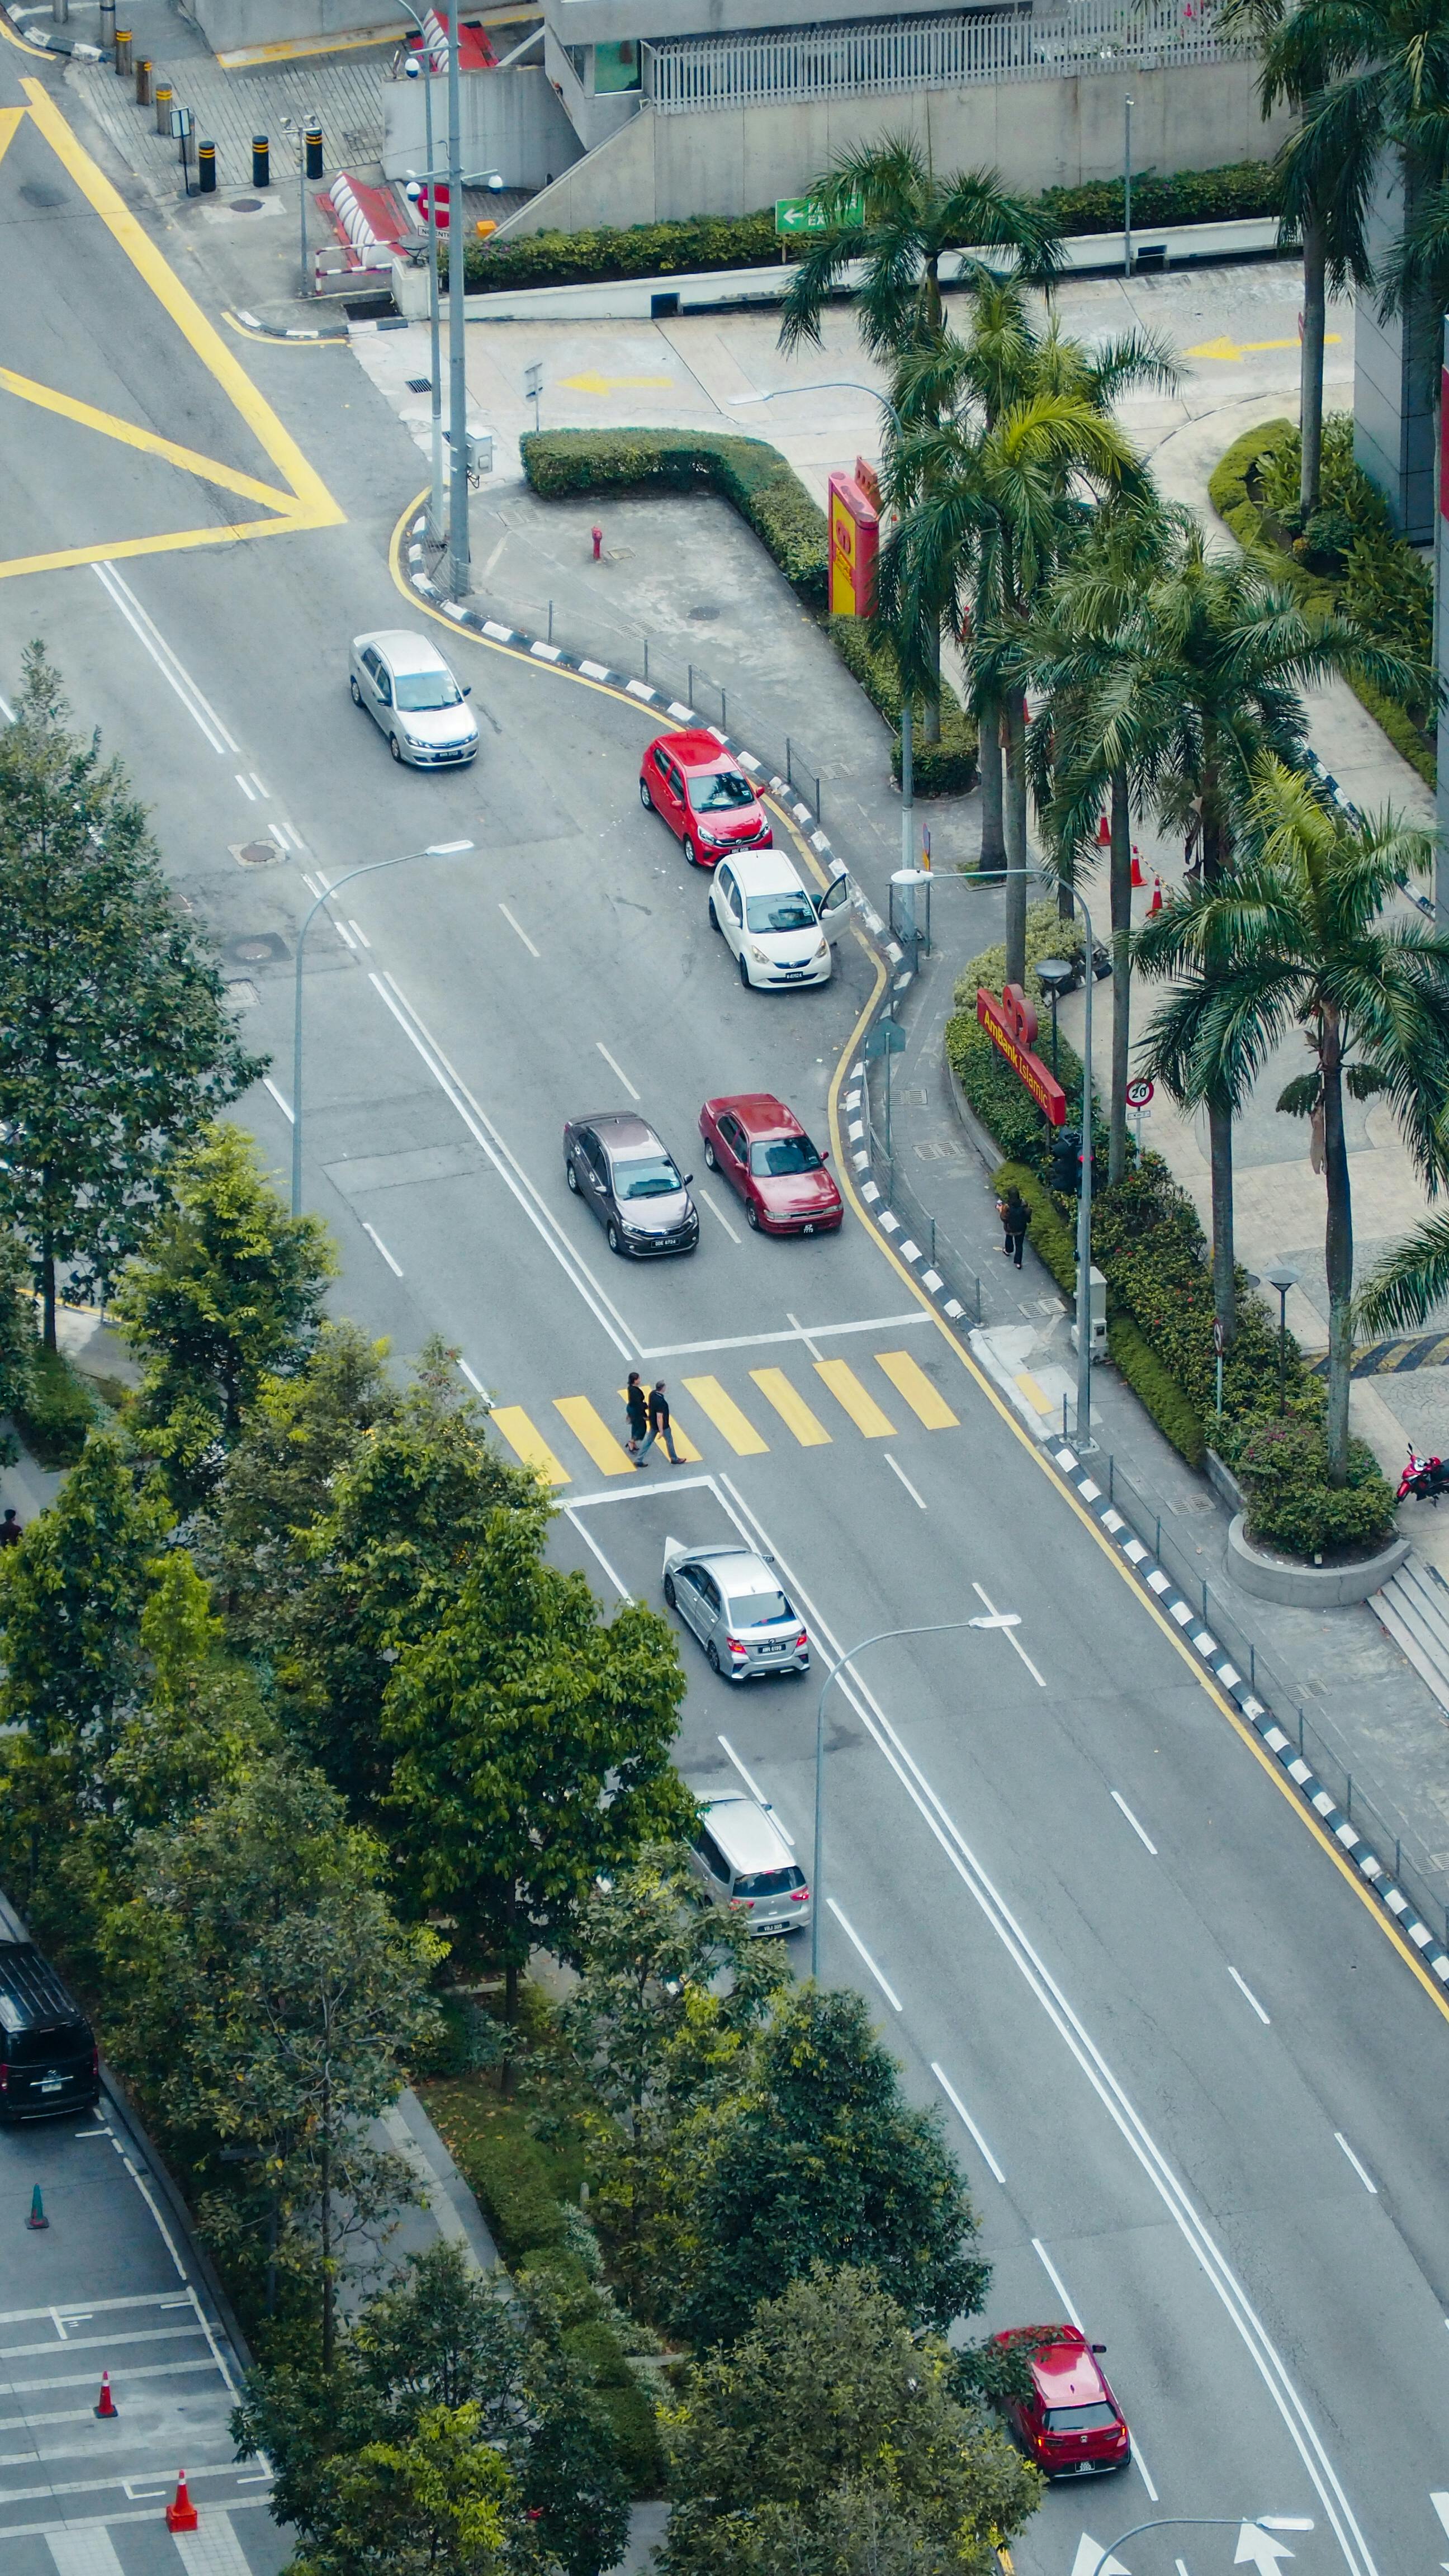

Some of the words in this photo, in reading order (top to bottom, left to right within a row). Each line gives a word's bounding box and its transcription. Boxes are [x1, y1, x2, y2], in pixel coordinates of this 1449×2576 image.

[984, 1010, 1017, 1067] AmBank
[1019, 1055, 1048, 1109] Islamic
[1132, 1087, 1146, 1098] 20
